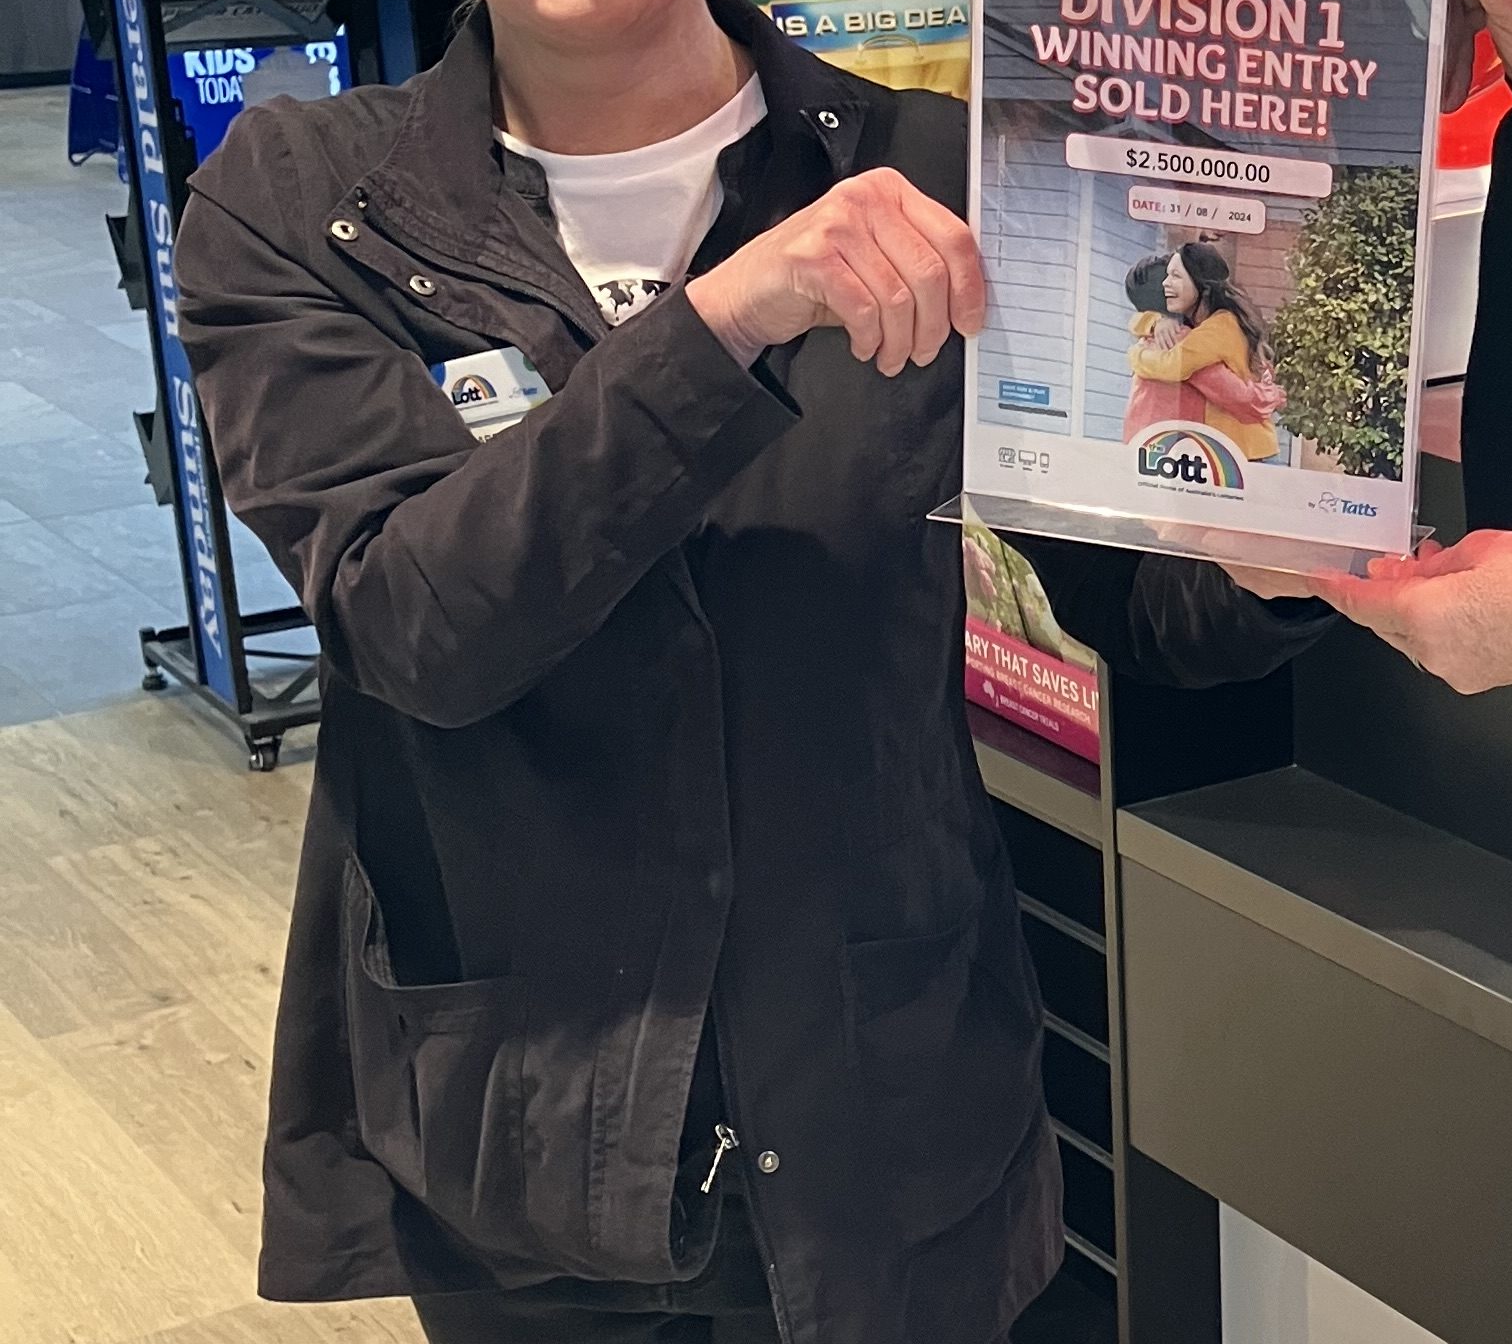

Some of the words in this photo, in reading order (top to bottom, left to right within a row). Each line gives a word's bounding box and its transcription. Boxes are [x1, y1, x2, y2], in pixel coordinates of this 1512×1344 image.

[816, 15, 837, 35] A
[844, 10, 897, 33] BIG
[1317, 1, 1345, 49] 1
[183, 47, 255, 78] KIDS
[1030, 24, 1226, 82] WINNING
[1237, 47, 1377, 97] ENTRY
[195, 75, 245, 104] TODA
[1072, 73, 1191, 122] SOLD
[1201, 88, 1330, 138] HERE!
[1126, 147, 1271, 184] $2,500,000.00
[1131, 198, 1166, 213] DATE:
[1170, 203, 1181, 214] 31
[1195, 206, 1208, 217] 08
[1229, 210, 1252, 223] 2024
[149, 199, 180, 338] Sun
[451, 386, 482, 405] Lott
[1138, 447, 1207, 484] Lott
[1341, 499, 1378, 518] Tatts
[992, 643, 1028, 678] THAT
[1032, 663, 1079, 703] SAVES
